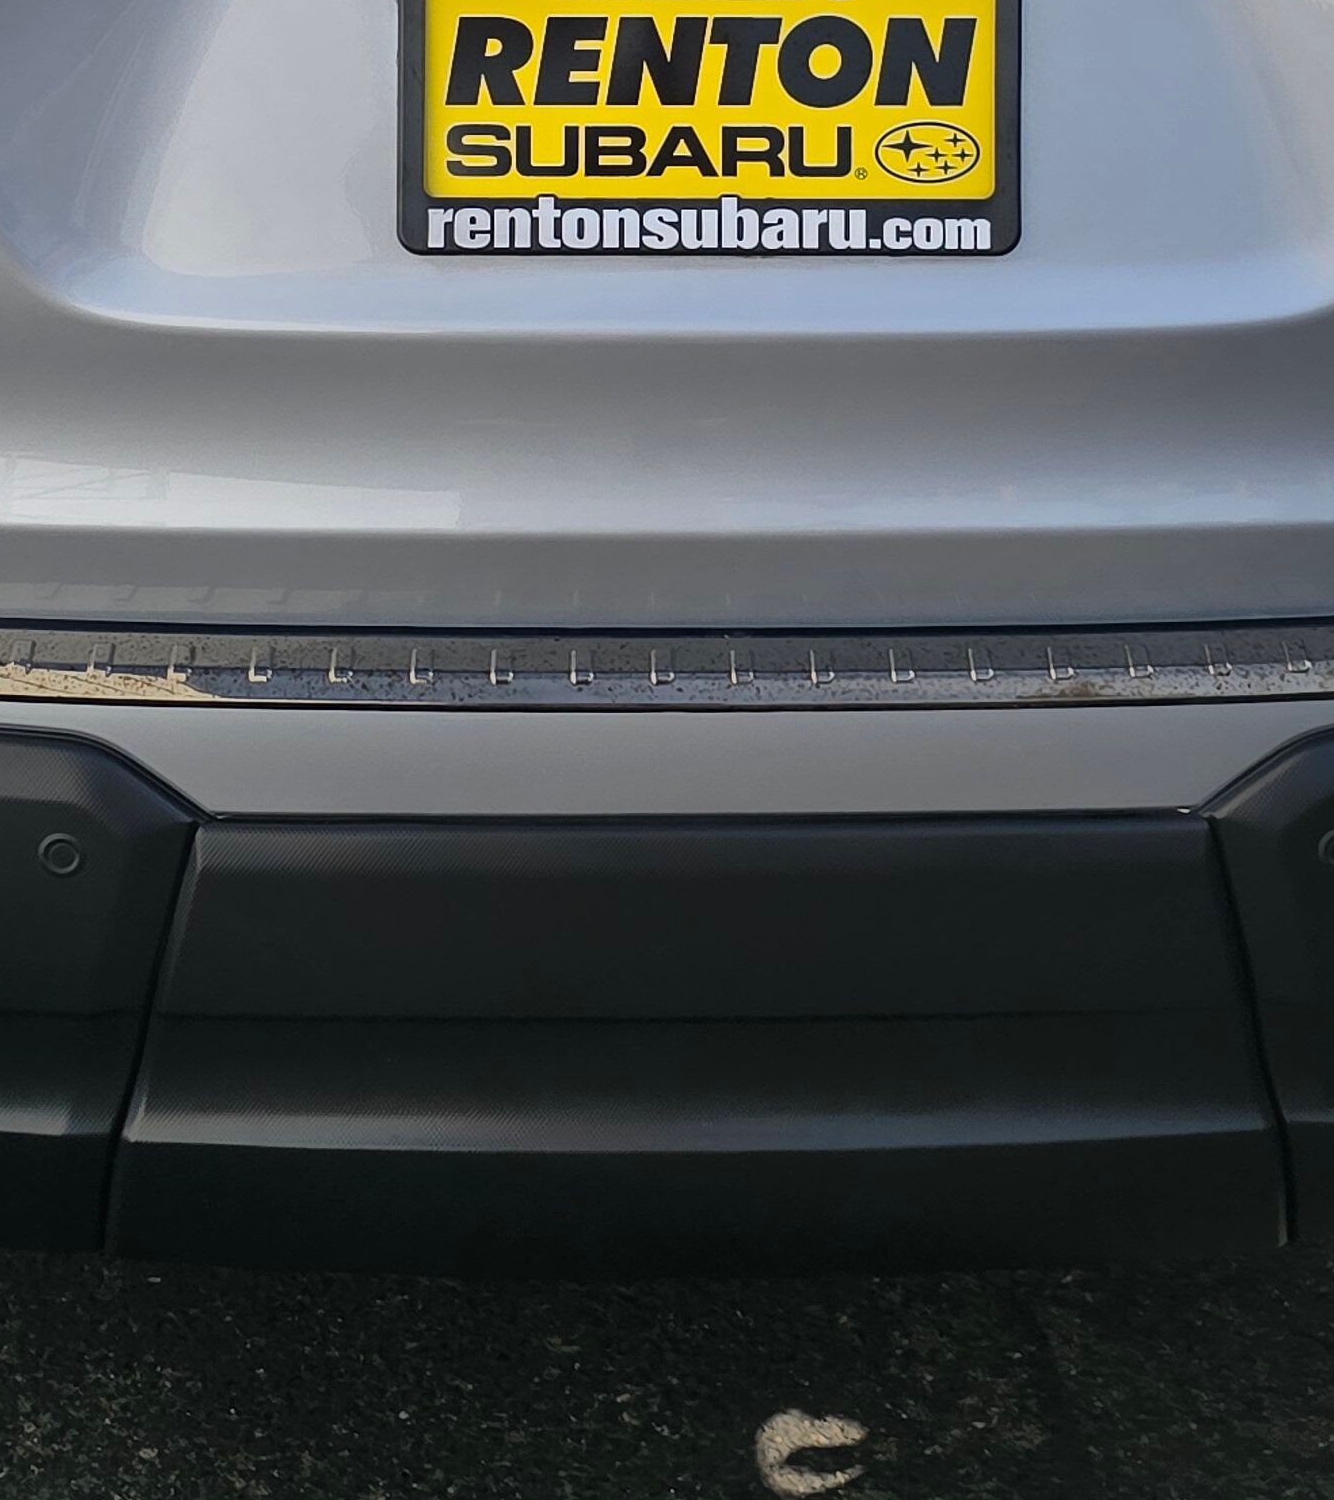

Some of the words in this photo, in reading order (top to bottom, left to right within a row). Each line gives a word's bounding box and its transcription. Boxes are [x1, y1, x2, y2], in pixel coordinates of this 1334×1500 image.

[445, 15, 977, 108] RENTON
[446, 124, 853, 177] SUBARU
[426, 198, 992, 250] rentonsubaru.com
